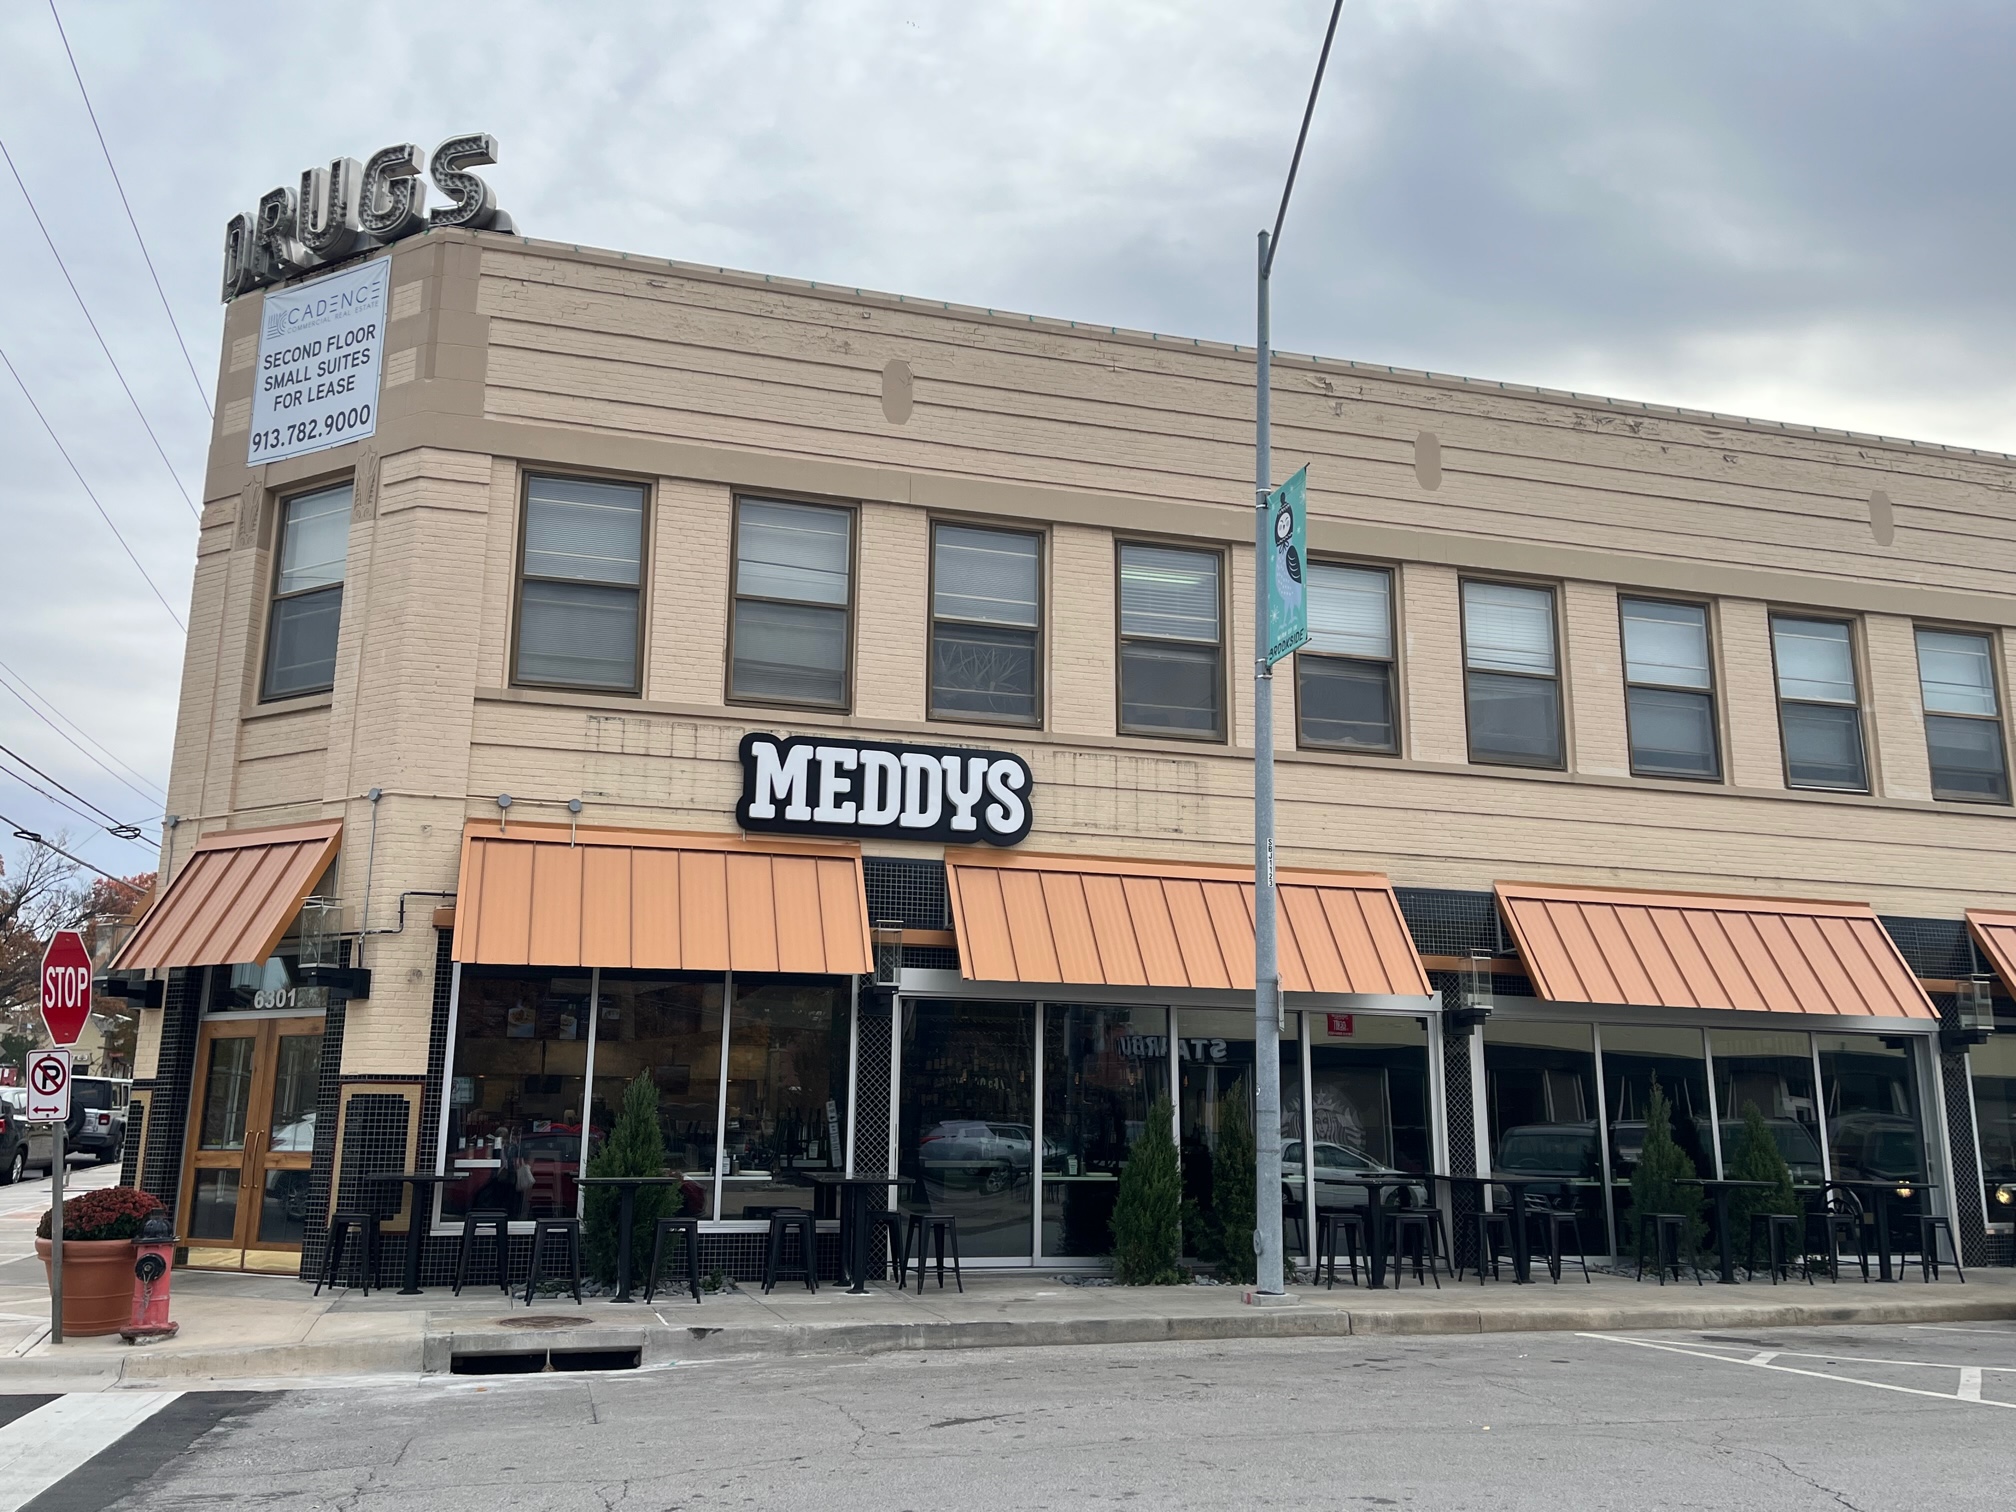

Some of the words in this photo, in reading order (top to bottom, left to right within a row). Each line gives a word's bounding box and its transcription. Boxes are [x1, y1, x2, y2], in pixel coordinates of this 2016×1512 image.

[222, 132, 498, 304] DRUGS
[286, 316, 331, 334] COMMERCIAL
[334, 310, 351, 320] REAL
[354, 301, 379, 314] ESTATE
[287, 280, 380, 325] CADENCE
[263, 340, 322, 370] SECOND
[326, 323, 376, 353] FLOOR
[264, 366, 312, 392] SMALL
[317, 348, 371, 377] SUITES
[273, 390, 303, 412] FOR
[307, 375, 356, 403] LEASE
[252, 404, 371, 453] 913.782.9000
[1268, 627, 1305, 661] BROOKSIDE
[749, 741, 1026, 834] MEDDYS
[45, 965, 88, 1008] STOP
[254, 988, 296, 1009] 6301
